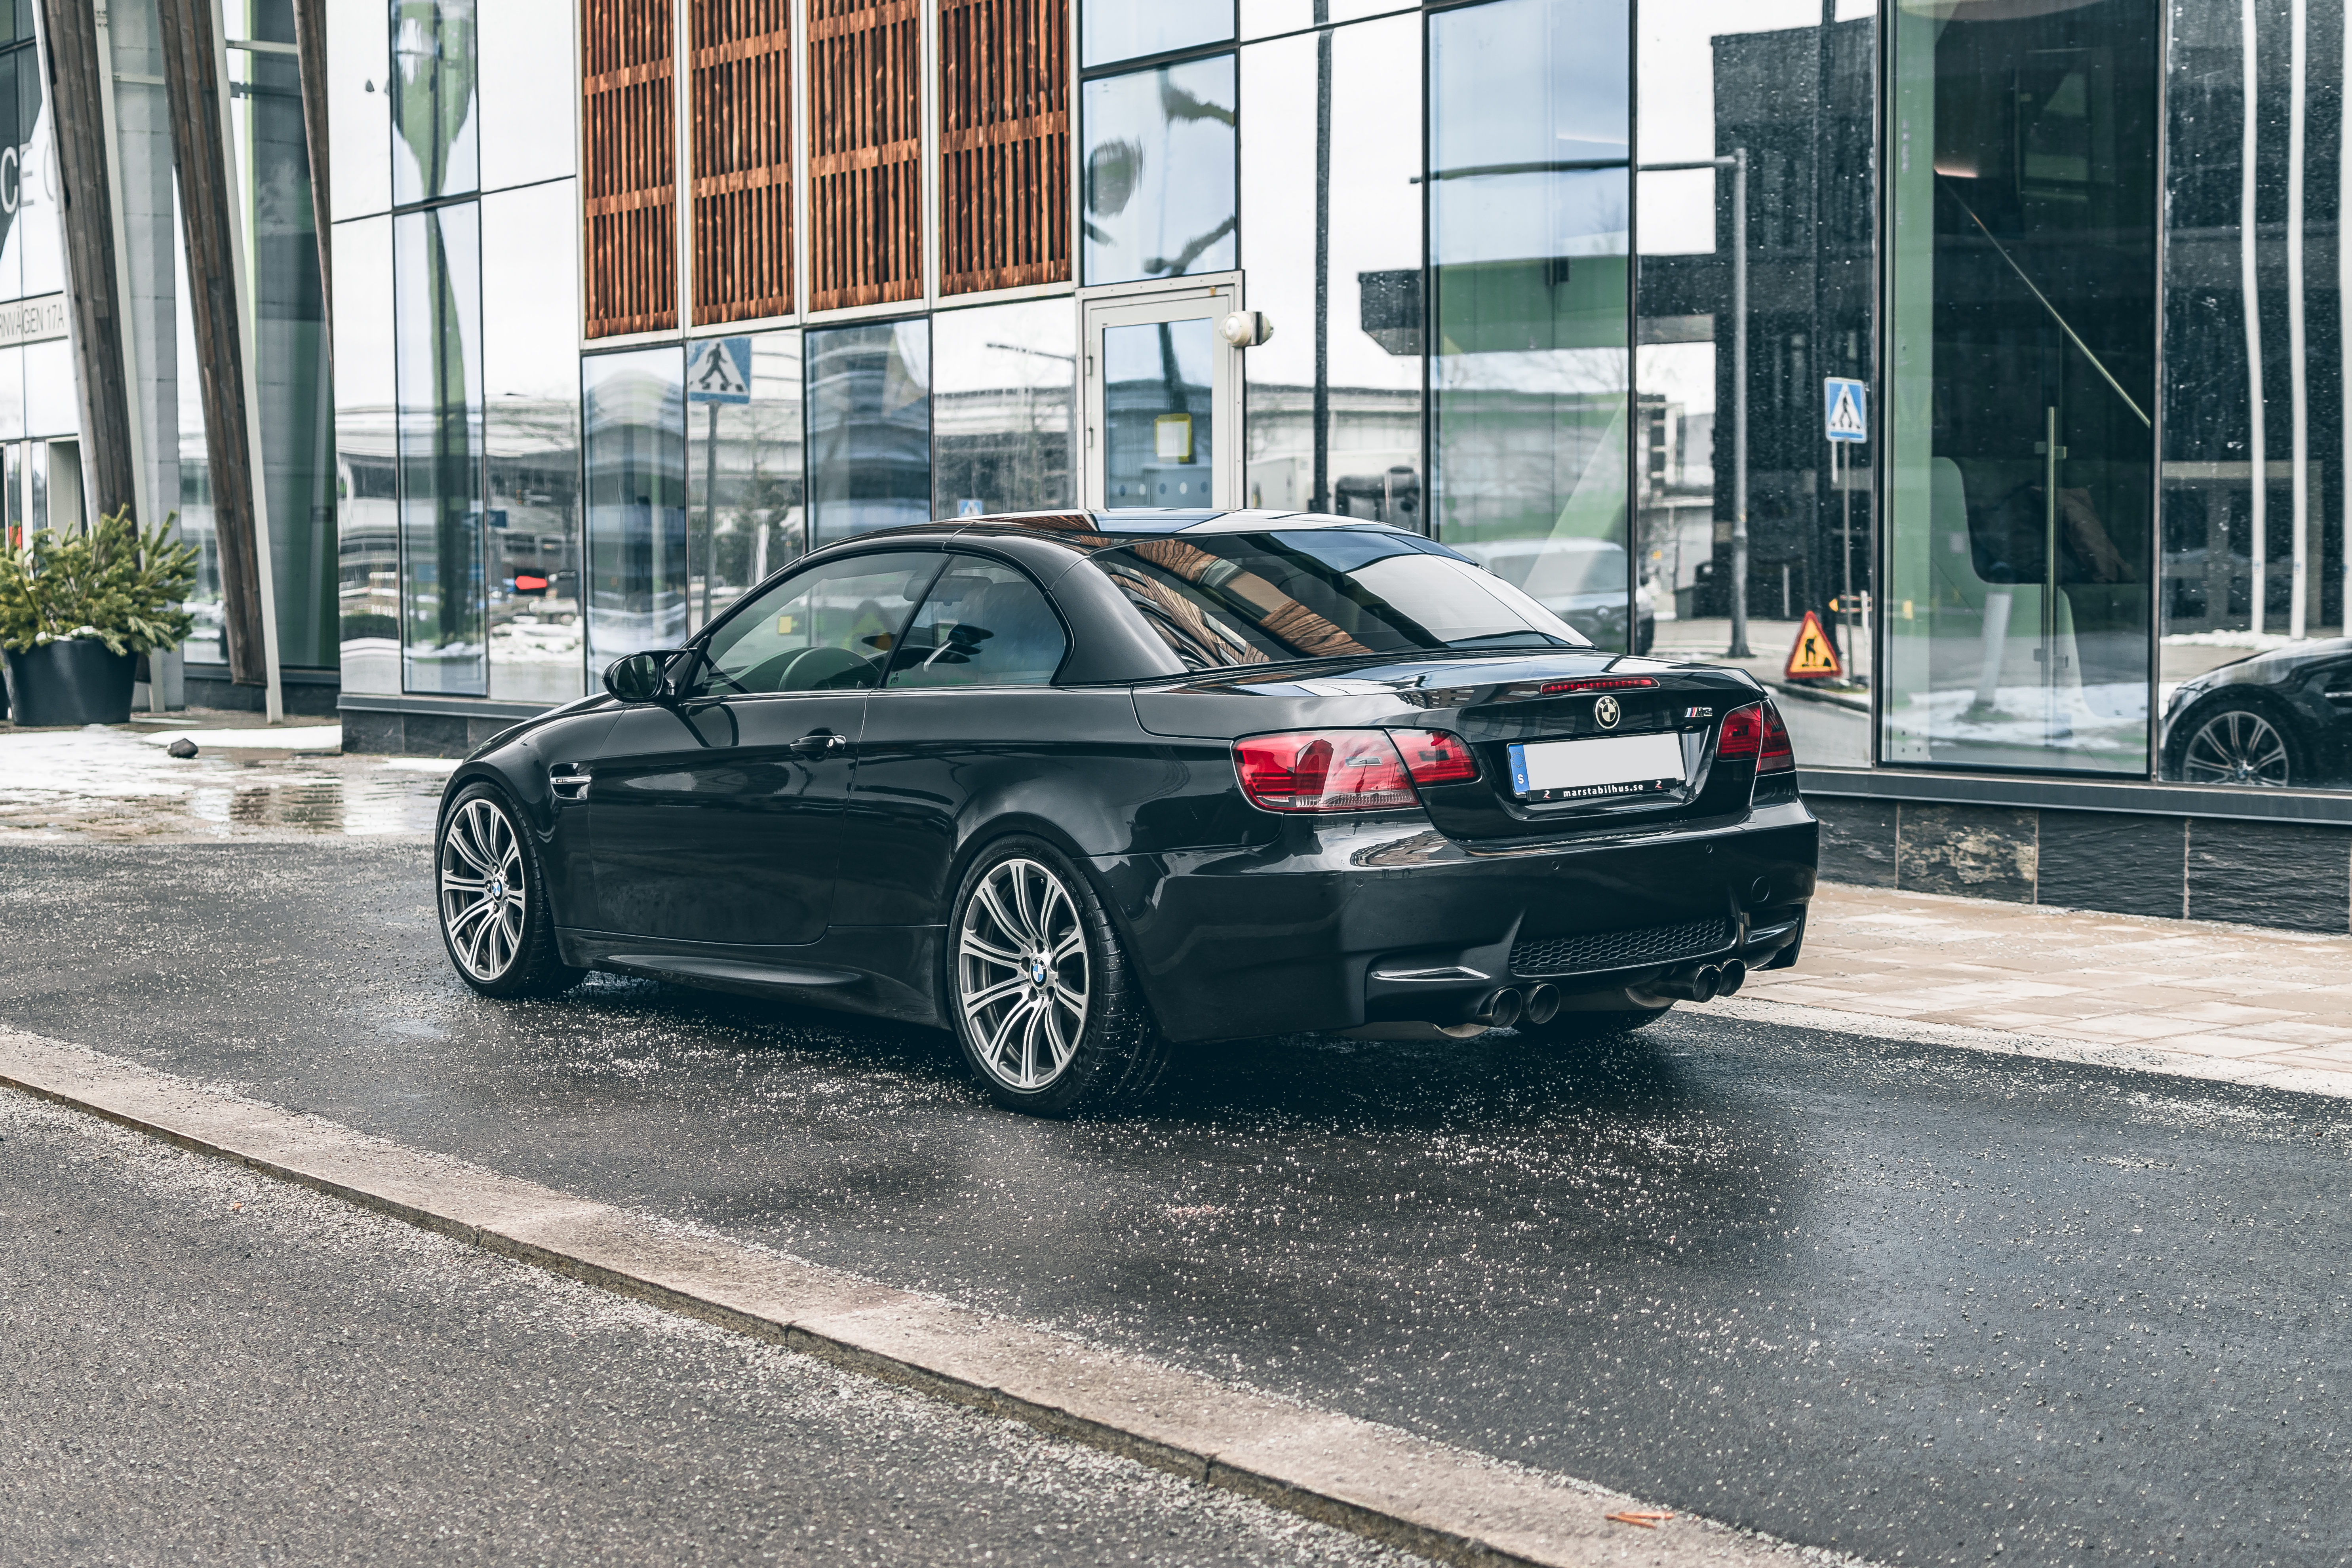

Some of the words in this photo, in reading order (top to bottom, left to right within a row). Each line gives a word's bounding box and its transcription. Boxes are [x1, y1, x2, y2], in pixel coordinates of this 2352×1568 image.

[47, 303, 65, 330] 17A
[1517, 774, 1524, 784] S
[1563, 784, 1644, 797] marstabilhus.se
